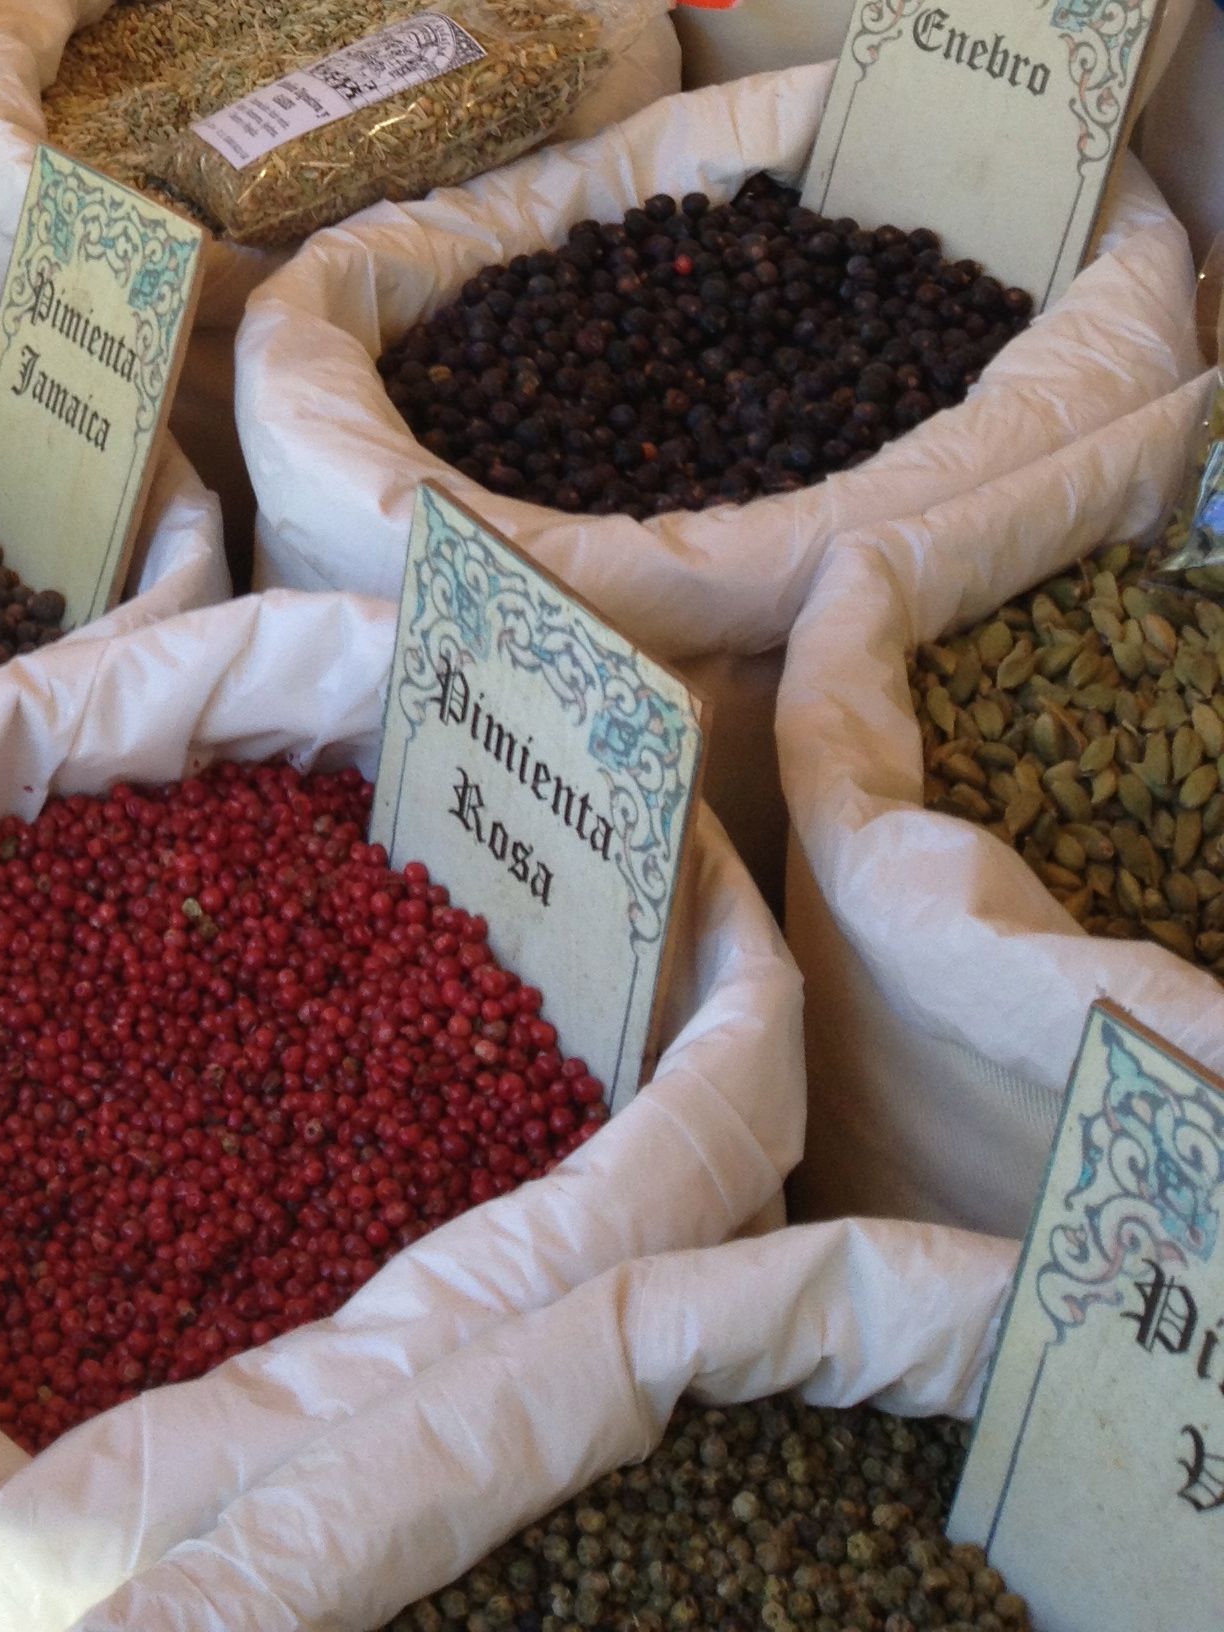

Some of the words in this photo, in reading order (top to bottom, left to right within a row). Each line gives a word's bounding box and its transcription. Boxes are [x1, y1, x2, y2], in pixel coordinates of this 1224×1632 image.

[912, 7, 1052, 97] Enebro
[28, 271, 137, 383] Pimienta
[10, 344, 112, 453] Jamaica
[428, 654, 614, 862] Pimienta
[447, 766, 554, 907] Rosa
